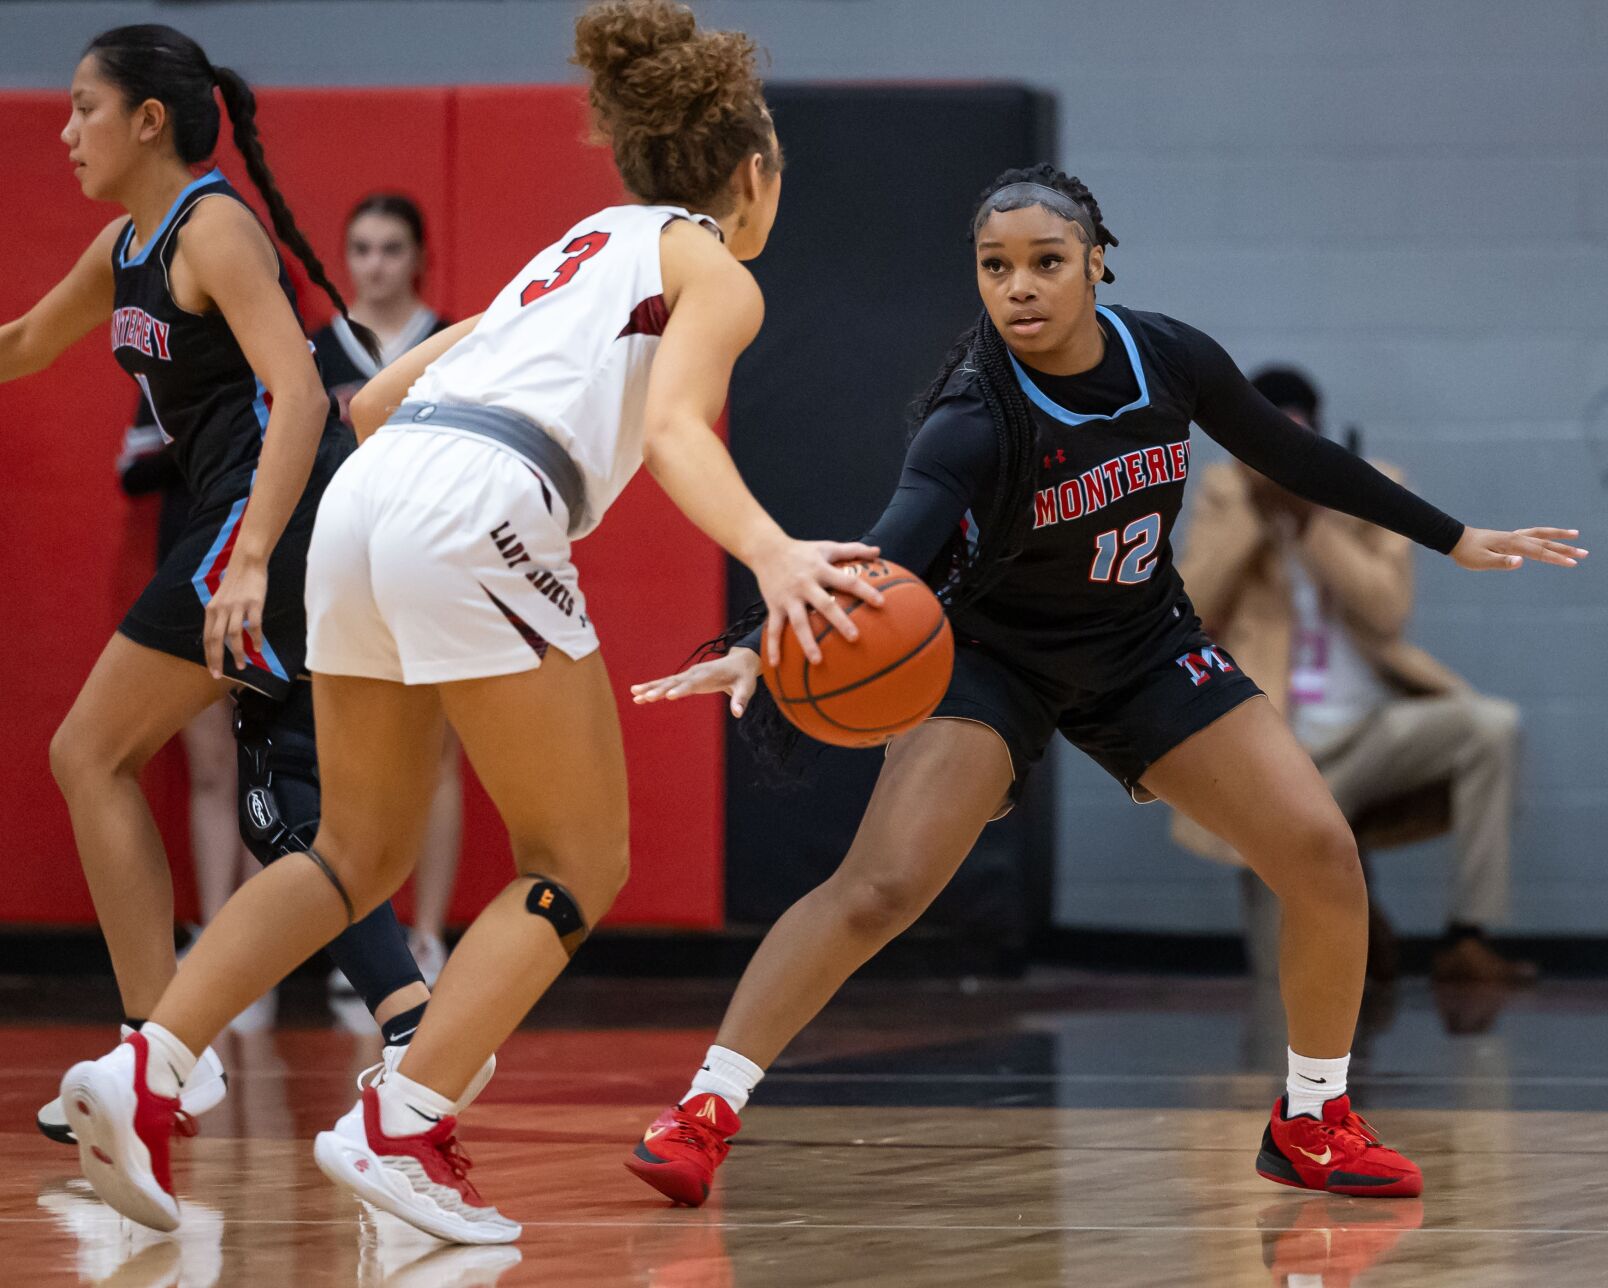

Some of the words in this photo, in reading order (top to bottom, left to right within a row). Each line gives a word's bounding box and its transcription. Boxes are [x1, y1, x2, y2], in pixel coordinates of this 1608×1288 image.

[520, 230, 612, 308] 3
[1032, 439, 1190, 530] MONTERE
[490, 520, 531, 569] LADY
[1089, 512, 1161, 584] 12
[1175, 644, 1234, 687] M
